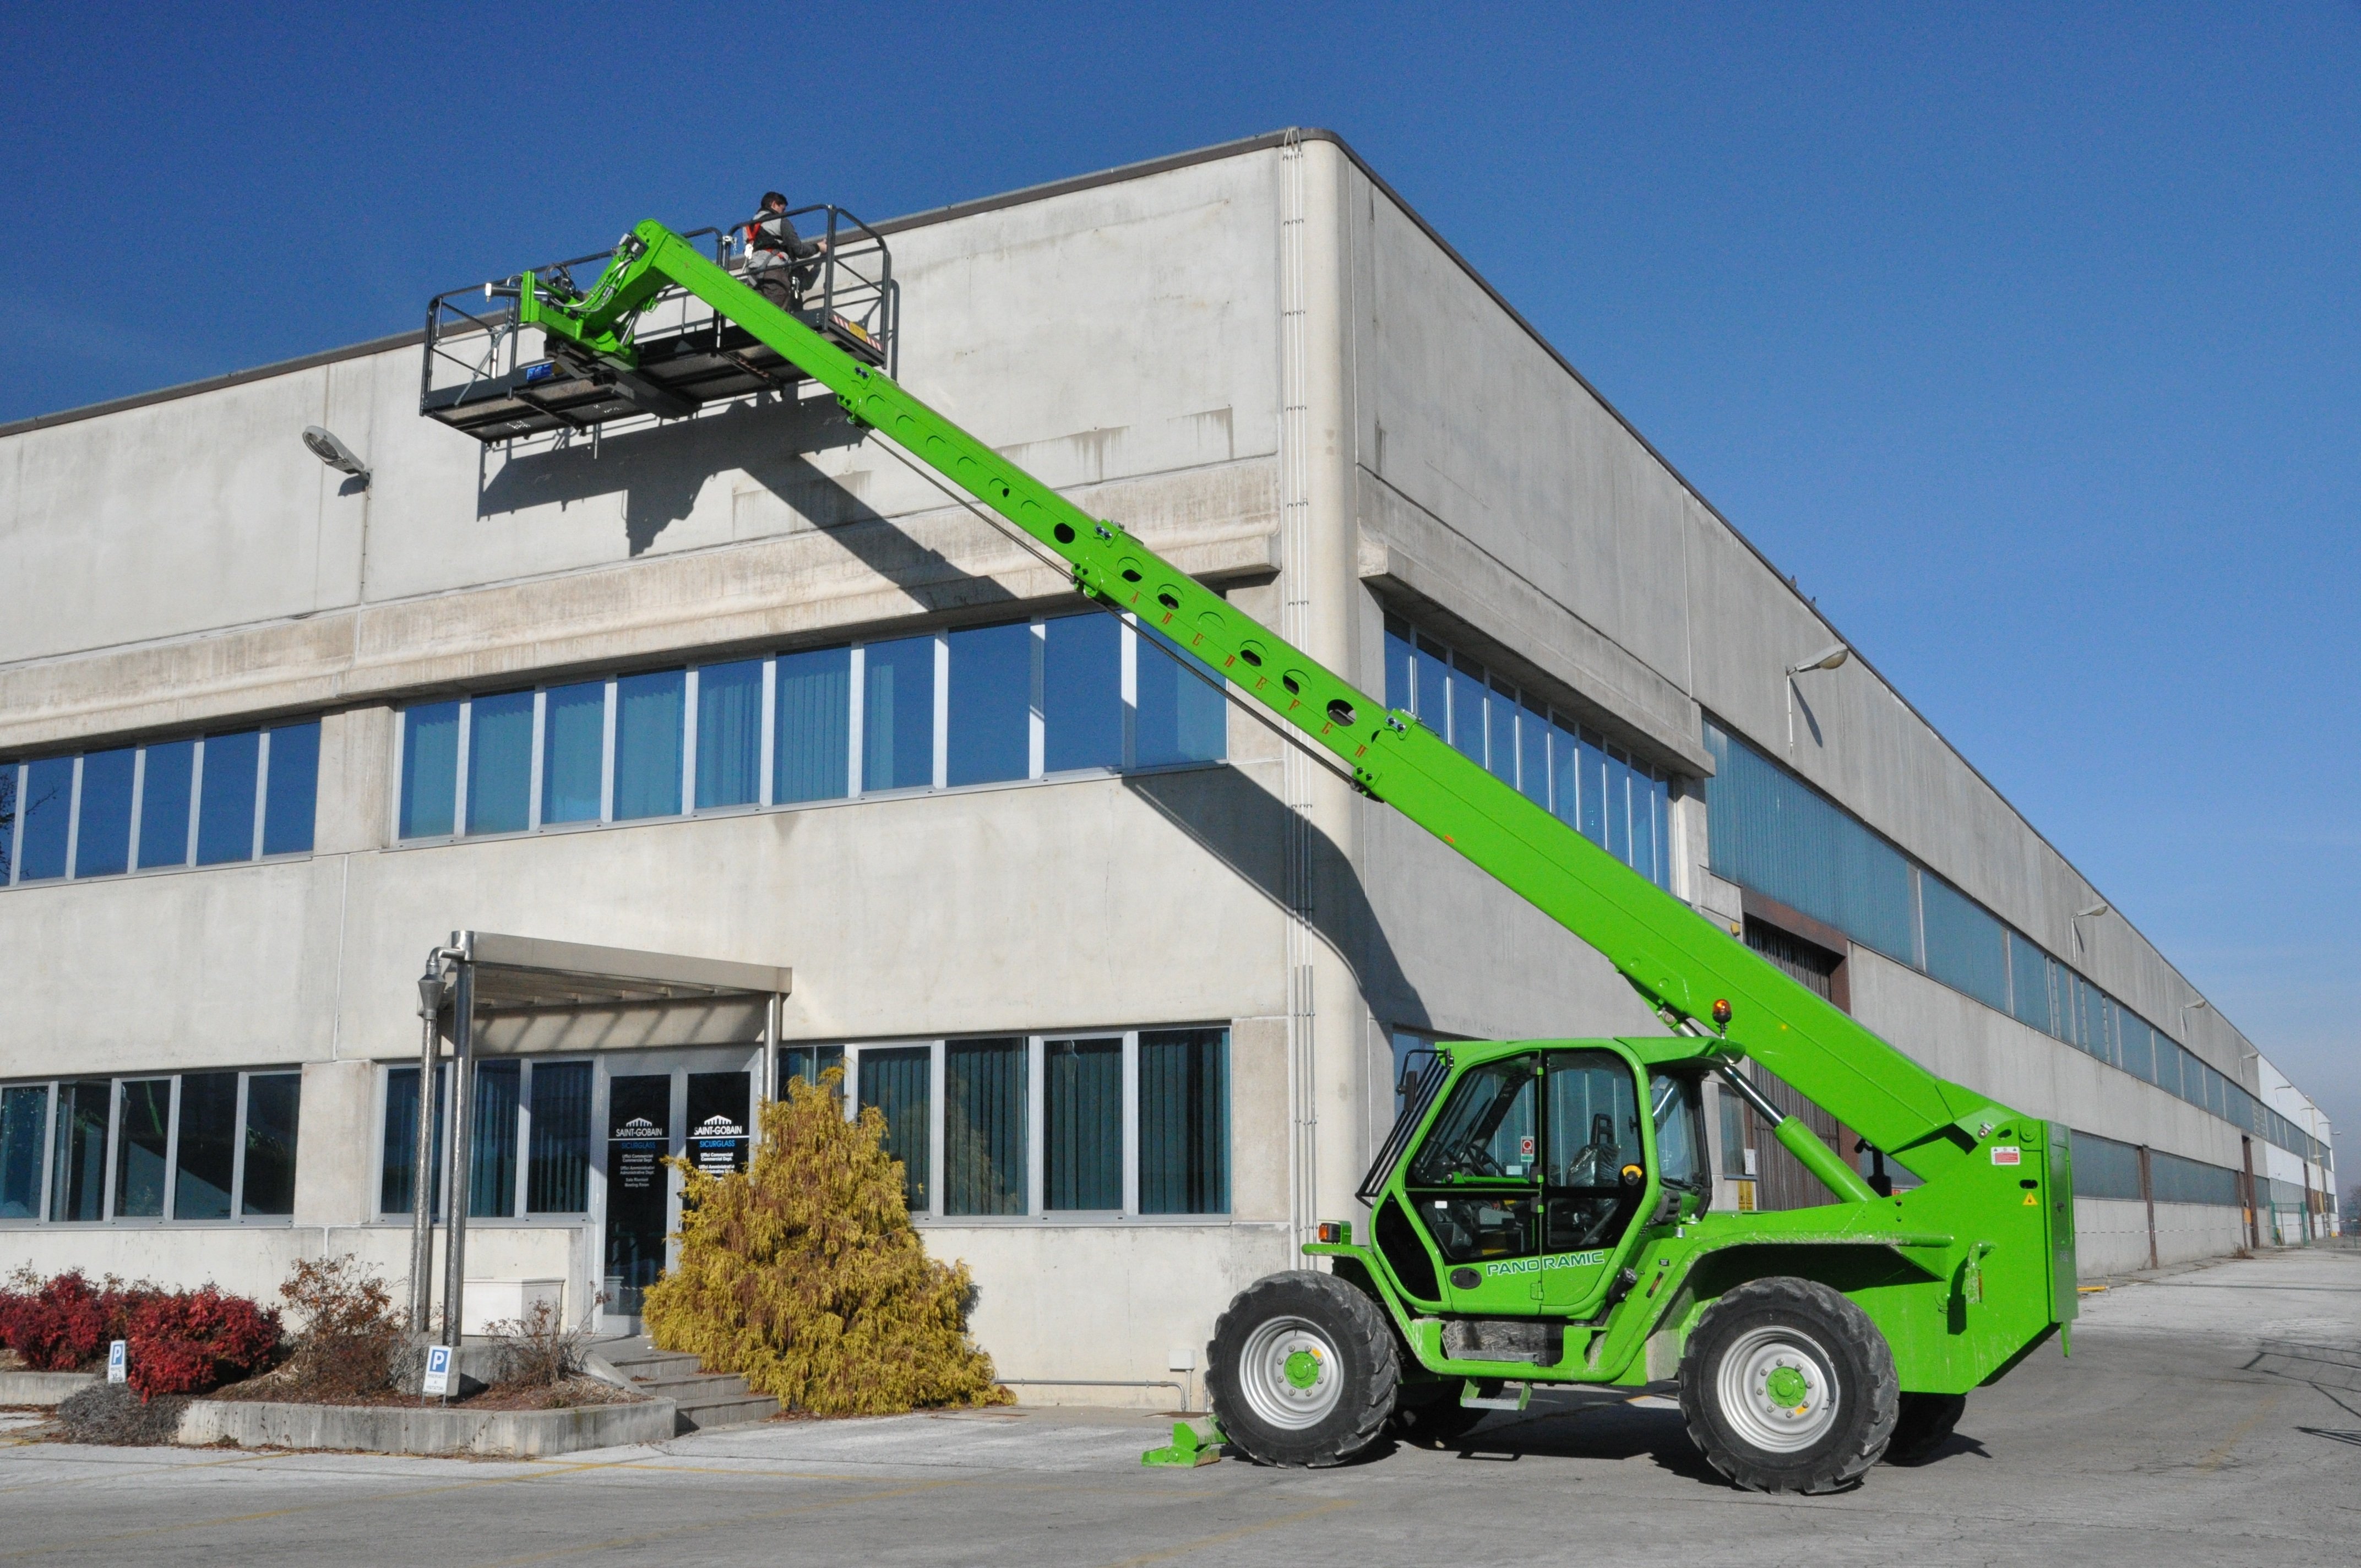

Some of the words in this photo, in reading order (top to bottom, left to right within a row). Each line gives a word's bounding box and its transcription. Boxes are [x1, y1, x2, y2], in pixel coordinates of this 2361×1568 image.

[1130, 591, 1140, 603] A
[1192, 633, 1204, 646] C
[1255, 676, 1267, 690] E
[1288, 699, 1301, 711] F
[1321, 721, 1334, 735] G
[616, 1128, 662, 1137] SAINT-GOBAIN
[694, 1125, 742, 1135] SAINT-GOBAIN
[1487, 1251, 1604, 1277] PANORAMIC
[113, 1346, 122, 1364] P
[432, 1351, 444, 1370] P
